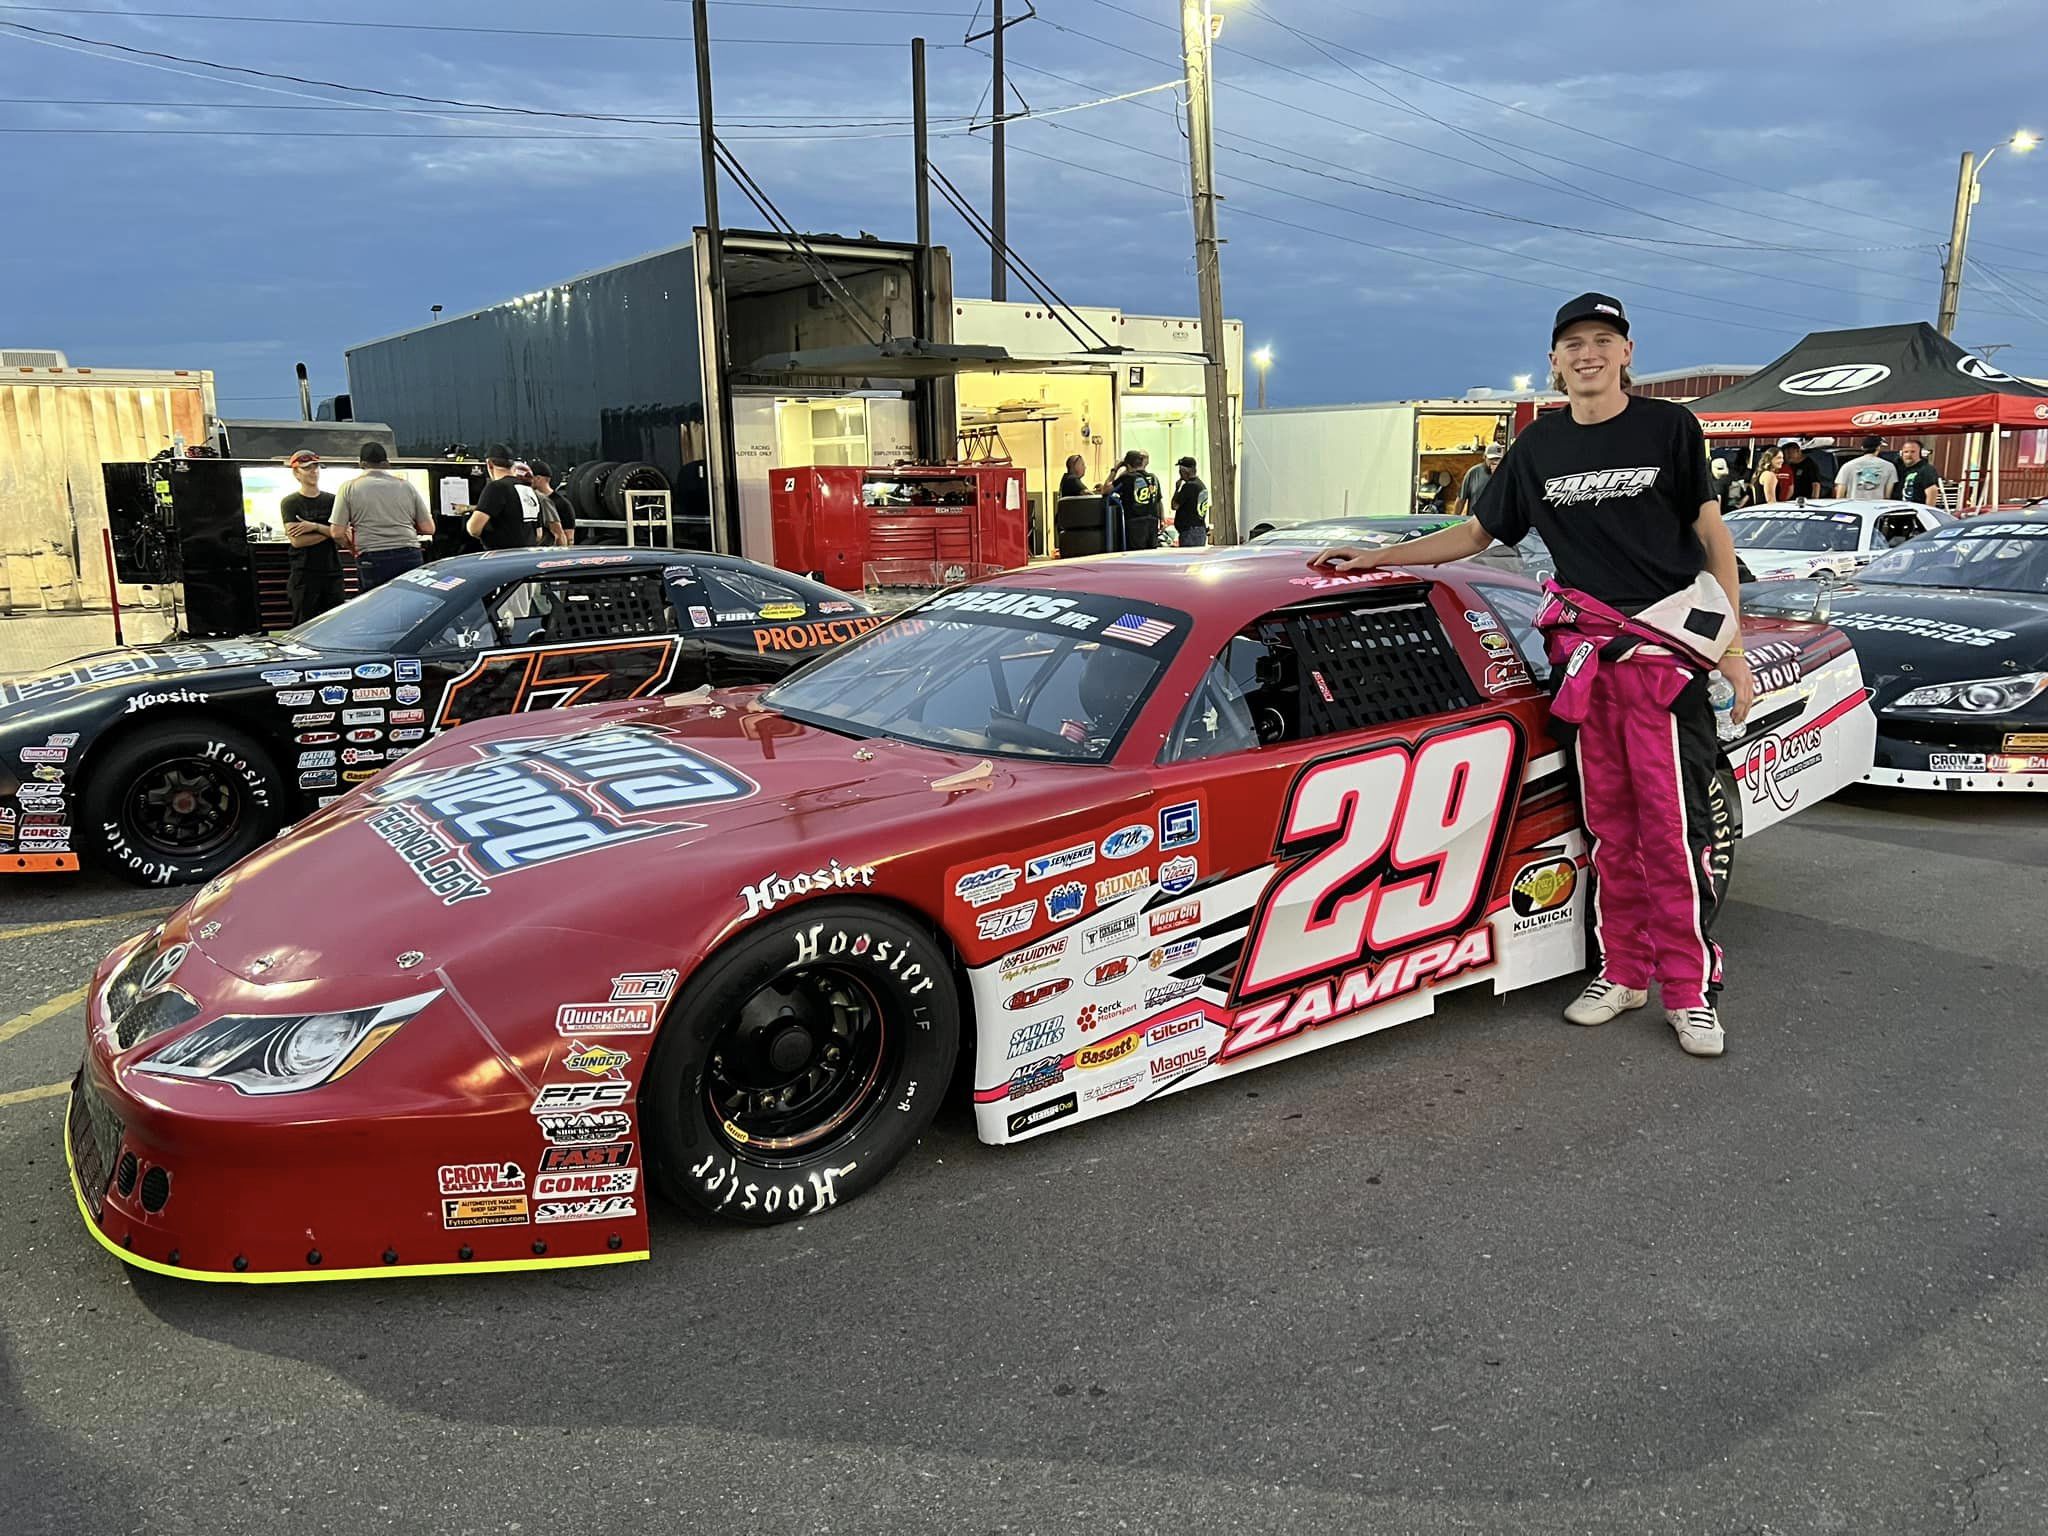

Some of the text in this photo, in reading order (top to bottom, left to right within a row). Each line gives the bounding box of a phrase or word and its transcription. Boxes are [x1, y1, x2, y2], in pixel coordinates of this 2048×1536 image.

[1546, 470, 1656, 497] ZAMPA
[716, 612, 756, 622] FURY
[918, 591, 1080, 619] SPEARS
[1744, 640, 1801, 668] ENTAL
[1753, 661, 1801, 696] GROUP
[124, 689, 209, 715] Hoosier
[1931, 755, 1970, 766] CROW
[197, 740, 270, 807] Hoosier
[22, 828, 58, 838] COMP
[103, 822, 179, 885] Hoosier
[367, 806, 491, 906] TECHNOLOGY
[1050, 846, 1094, 868] SENNEKER
[1238, 718, 1518, 998] 29
[736, 858, 878, 923] Hoosier
[1151, 903, 1200, 927] Motor City
[1513, 907, 1573, 932] KULWICKI
[786, 922, 934, 994] Hoosier
[1012, 939, 1066, 967] FLUIDYNE
[1221, 926, 1493, 1060] ZAMPA
[1097, 999, 1122, 1016] Serck
[1097, 1003, 1137, 1023] Motorsport
[1011, 1015, 1064, 1044] SALTED
[1150, 1017, 1200, 1042] tilton
[1008, 1028, 1066, 1059] METALS
[1080, 1036, 1133, 1066] Bassett
[570, 1055, 624, 1068] SUNOCO
[1149, 1046, 1207, 1076] Magnus
[540, 1084, 629, 1103] PFC
[555, 1127, 591, 1136] SHOCKS
[547, 1146, 625, 1167] FAST
[440, 1166, 499, 1185] CROW
[442, 1182, 490, 1192] SAFETY
[539, 1174, 612, 1194] COMP
[690, 1154, 841, 1216] Hoosier
[536, 1198, 632, 1217] Swift
[448, 1216, 525, 1227] FytronSoftware.com
